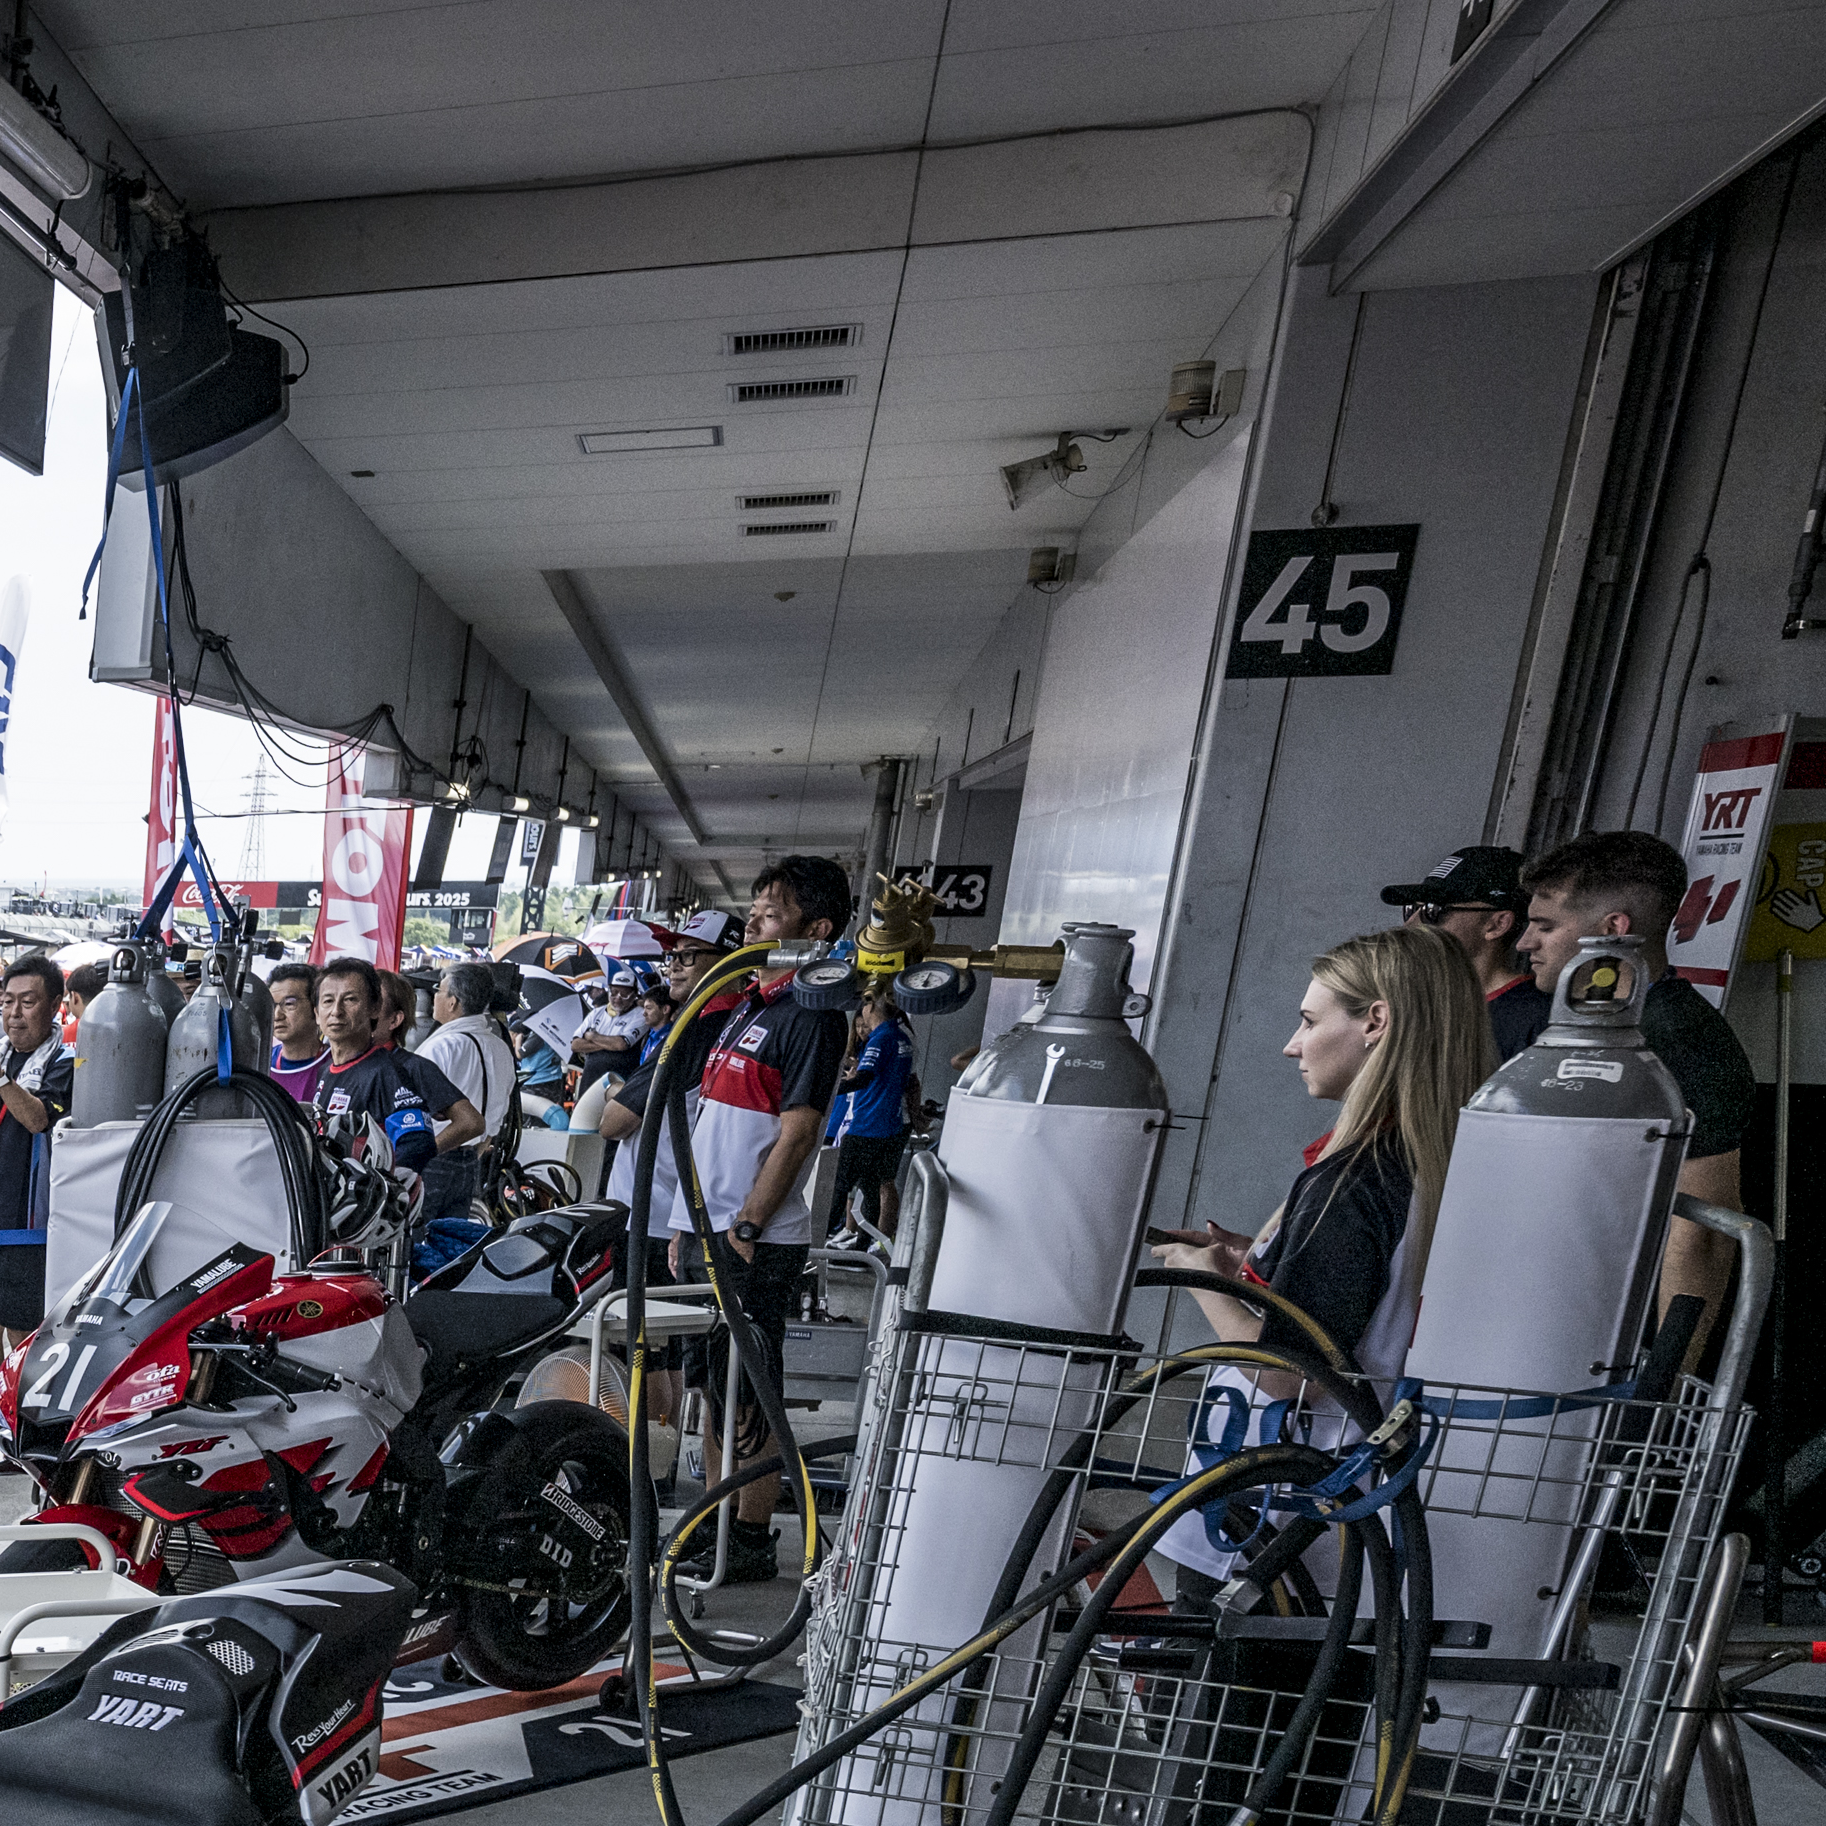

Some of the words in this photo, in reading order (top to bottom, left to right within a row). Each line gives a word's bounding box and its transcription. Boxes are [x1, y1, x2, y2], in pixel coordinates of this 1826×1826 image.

[1240, 552, 1400, 655] 45
[1702, 787, 1763, 831] YRT
[433, 893, 471, 907] 2025
[935, 873, 986, 910] 43
[189, 1258, 237, 1290] YAMALUBE
[74, 1313, 104, 1326] YAMAHA
[22, 1343, 97, 1410] 21
[544, 1485, 605, 1540] BRIDGESTONE
[539, 1534, 573, 1568] DID
[112, 1669, 148, 1686] RACE
[148, 1674, 188, 1693] SEATS
[87, 1694, 185, 1731] YART
[317, 1748, 374, 1808] YART
[433, 1772, 505, 1803] TEAM
